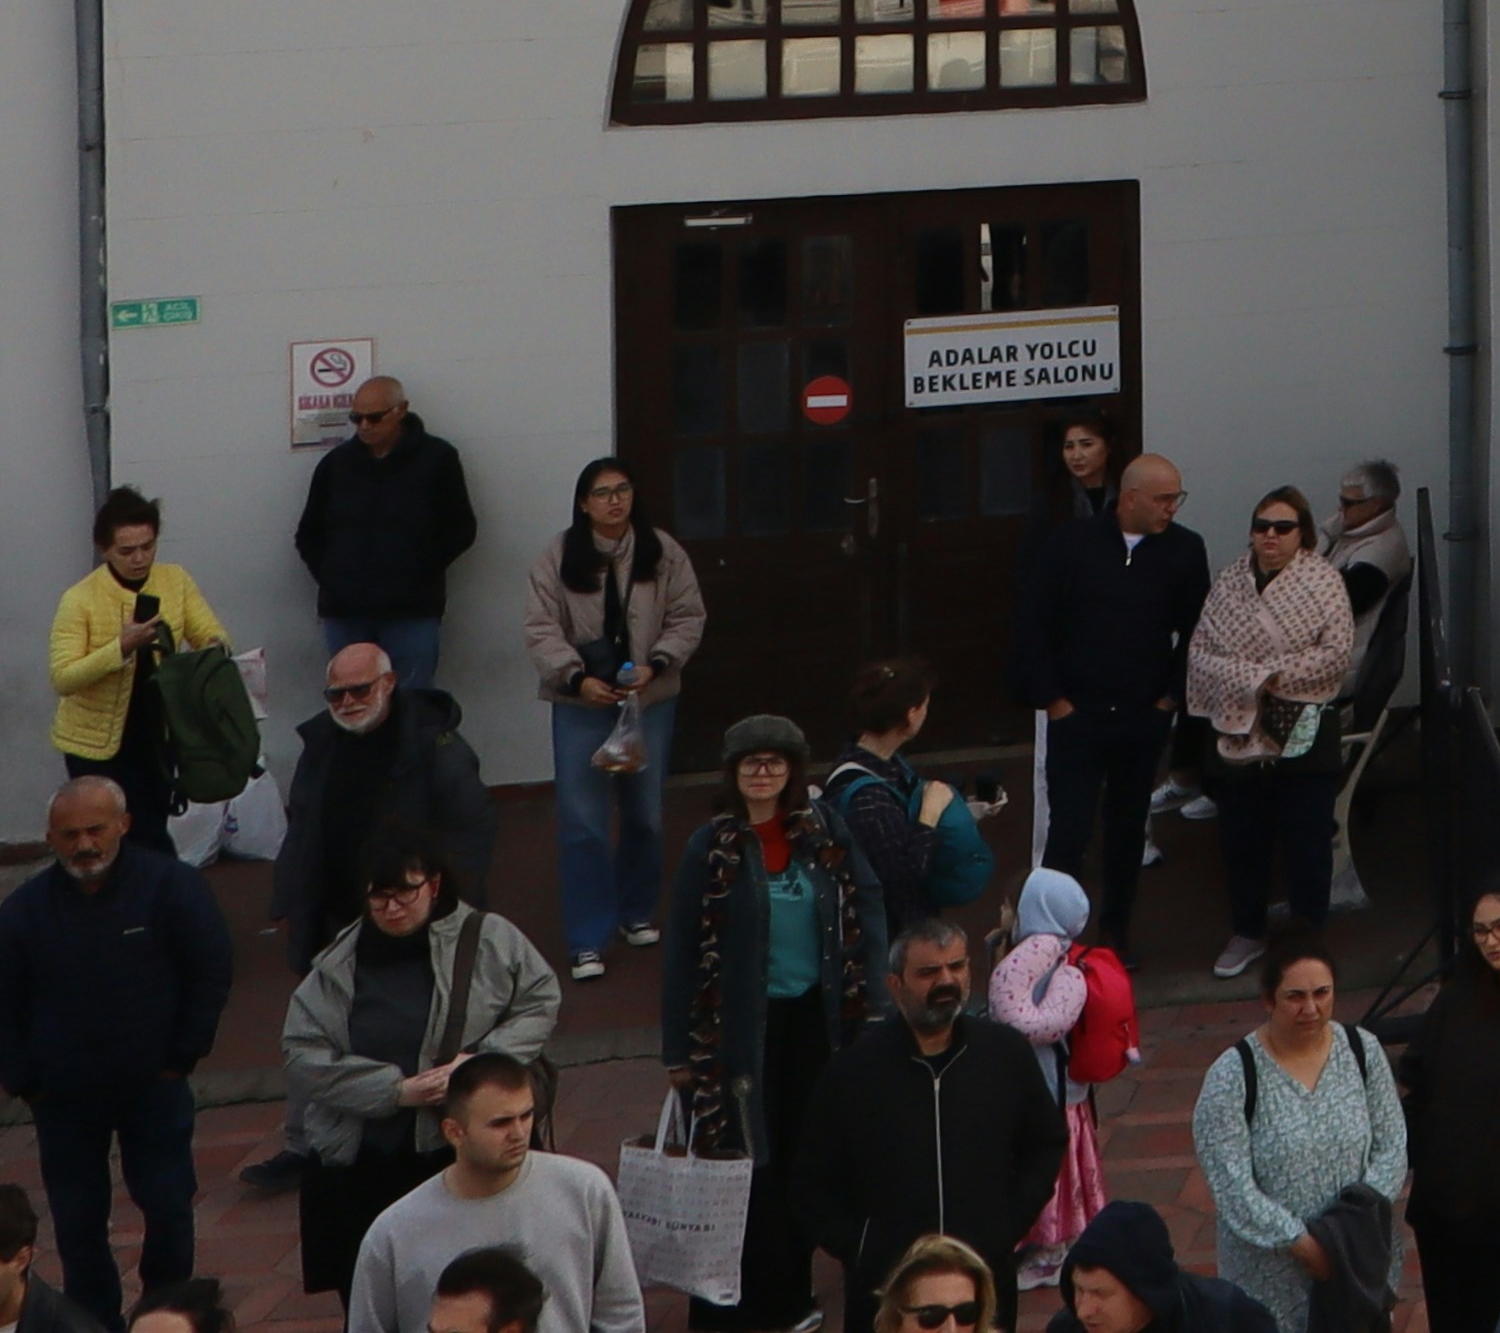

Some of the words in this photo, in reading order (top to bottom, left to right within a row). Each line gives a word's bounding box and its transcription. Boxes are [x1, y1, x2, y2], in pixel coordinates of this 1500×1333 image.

[928, 344, 1019, 369] ADALAR
[1025, 339, 1097, 361] YOLCU
[913, 369, 1017, 395] BEKLEME
[1023, 363, 1114, 386] SALONU
